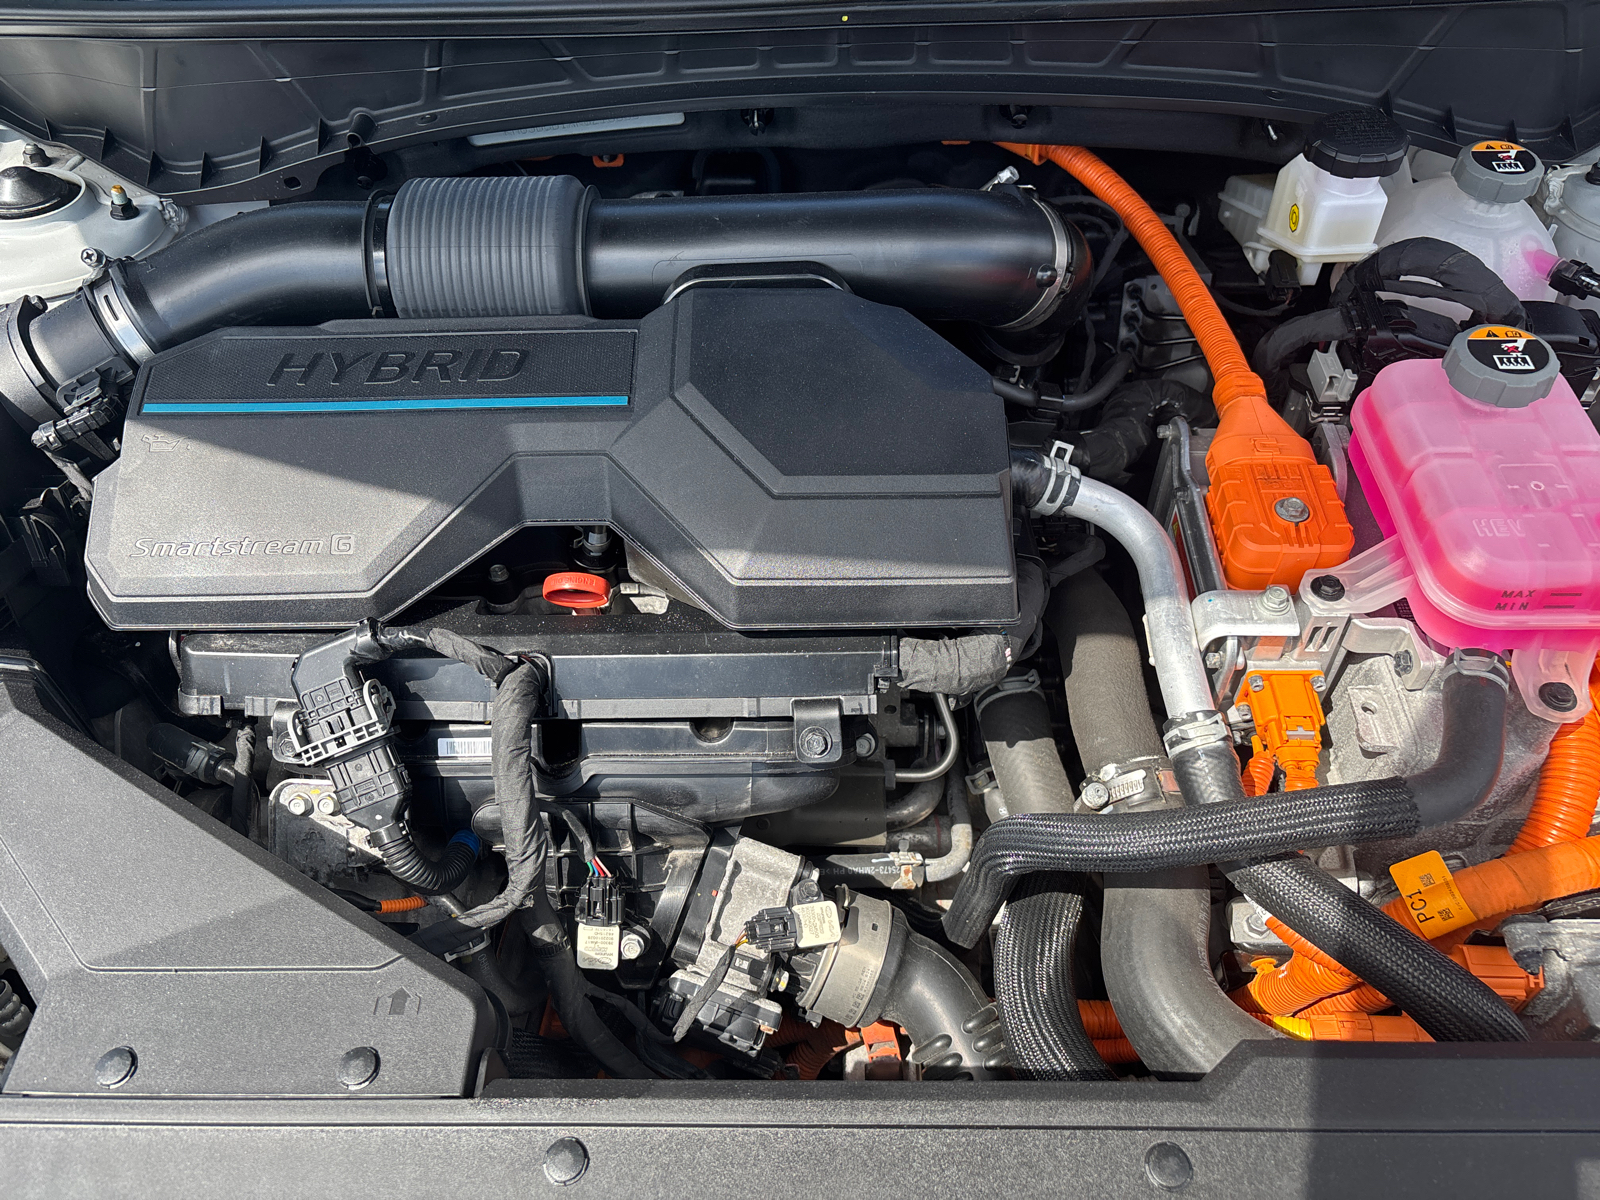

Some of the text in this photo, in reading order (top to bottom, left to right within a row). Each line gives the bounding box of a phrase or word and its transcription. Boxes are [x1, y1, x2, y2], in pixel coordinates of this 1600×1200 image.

[267, 350, 530, 386] HYBRID
[1472, 518, 1526, 537] HEV
[130, 536, 325, 557] Smartstream
[1501, 590, 1536, 598] MAX
[1495, 602, 1529, 611] MIN
[1406, 888, 1435, 924] PC1
